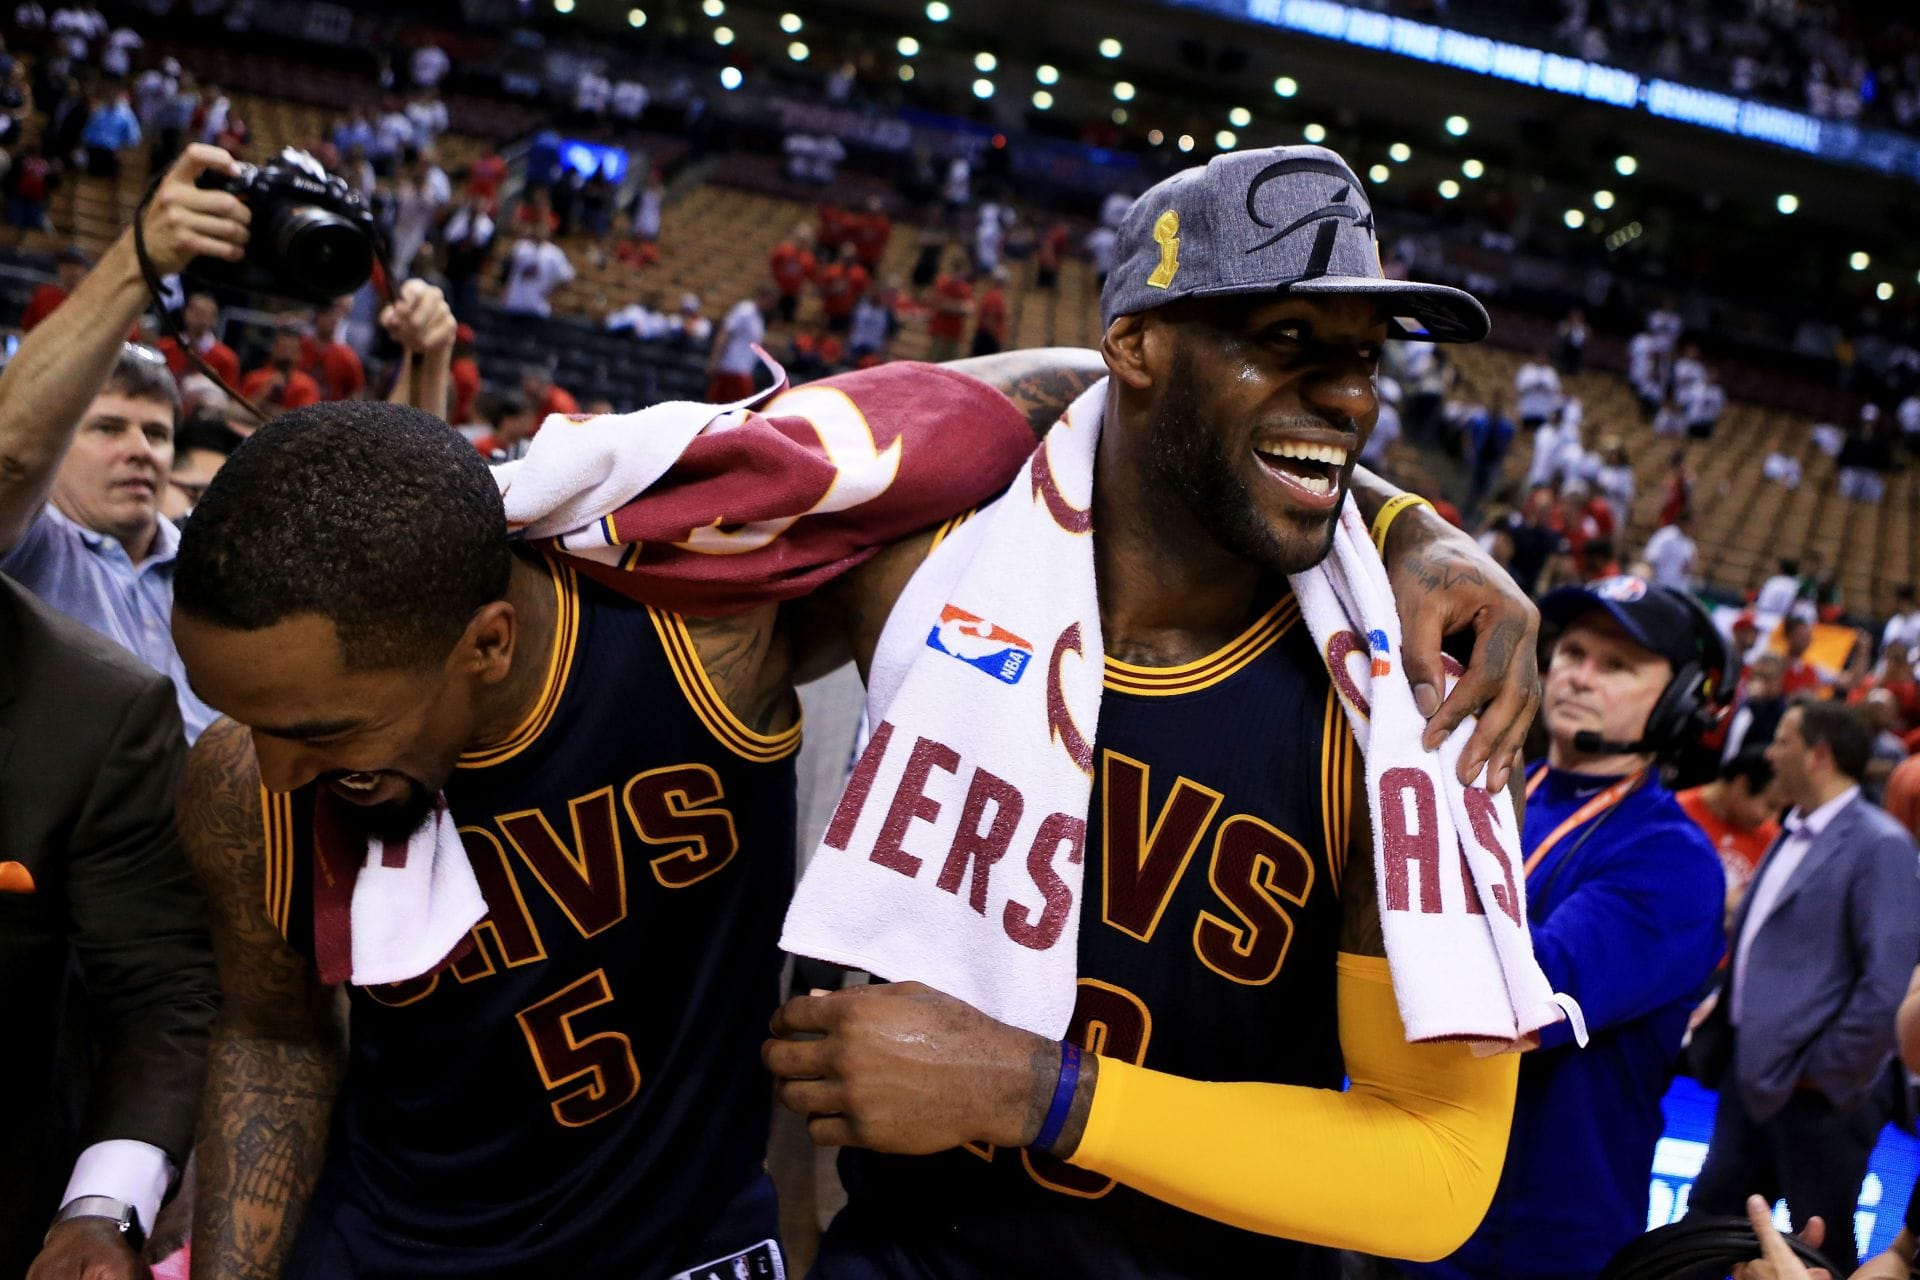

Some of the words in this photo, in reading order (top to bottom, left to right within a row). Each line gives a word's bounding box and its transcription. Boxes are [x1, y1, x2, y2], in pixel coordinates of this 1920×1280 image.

[1000, 651, 1025, 681] NBA
[823, 719, 1087, 951] IERS
[515, 968, 641, 1128] 5
